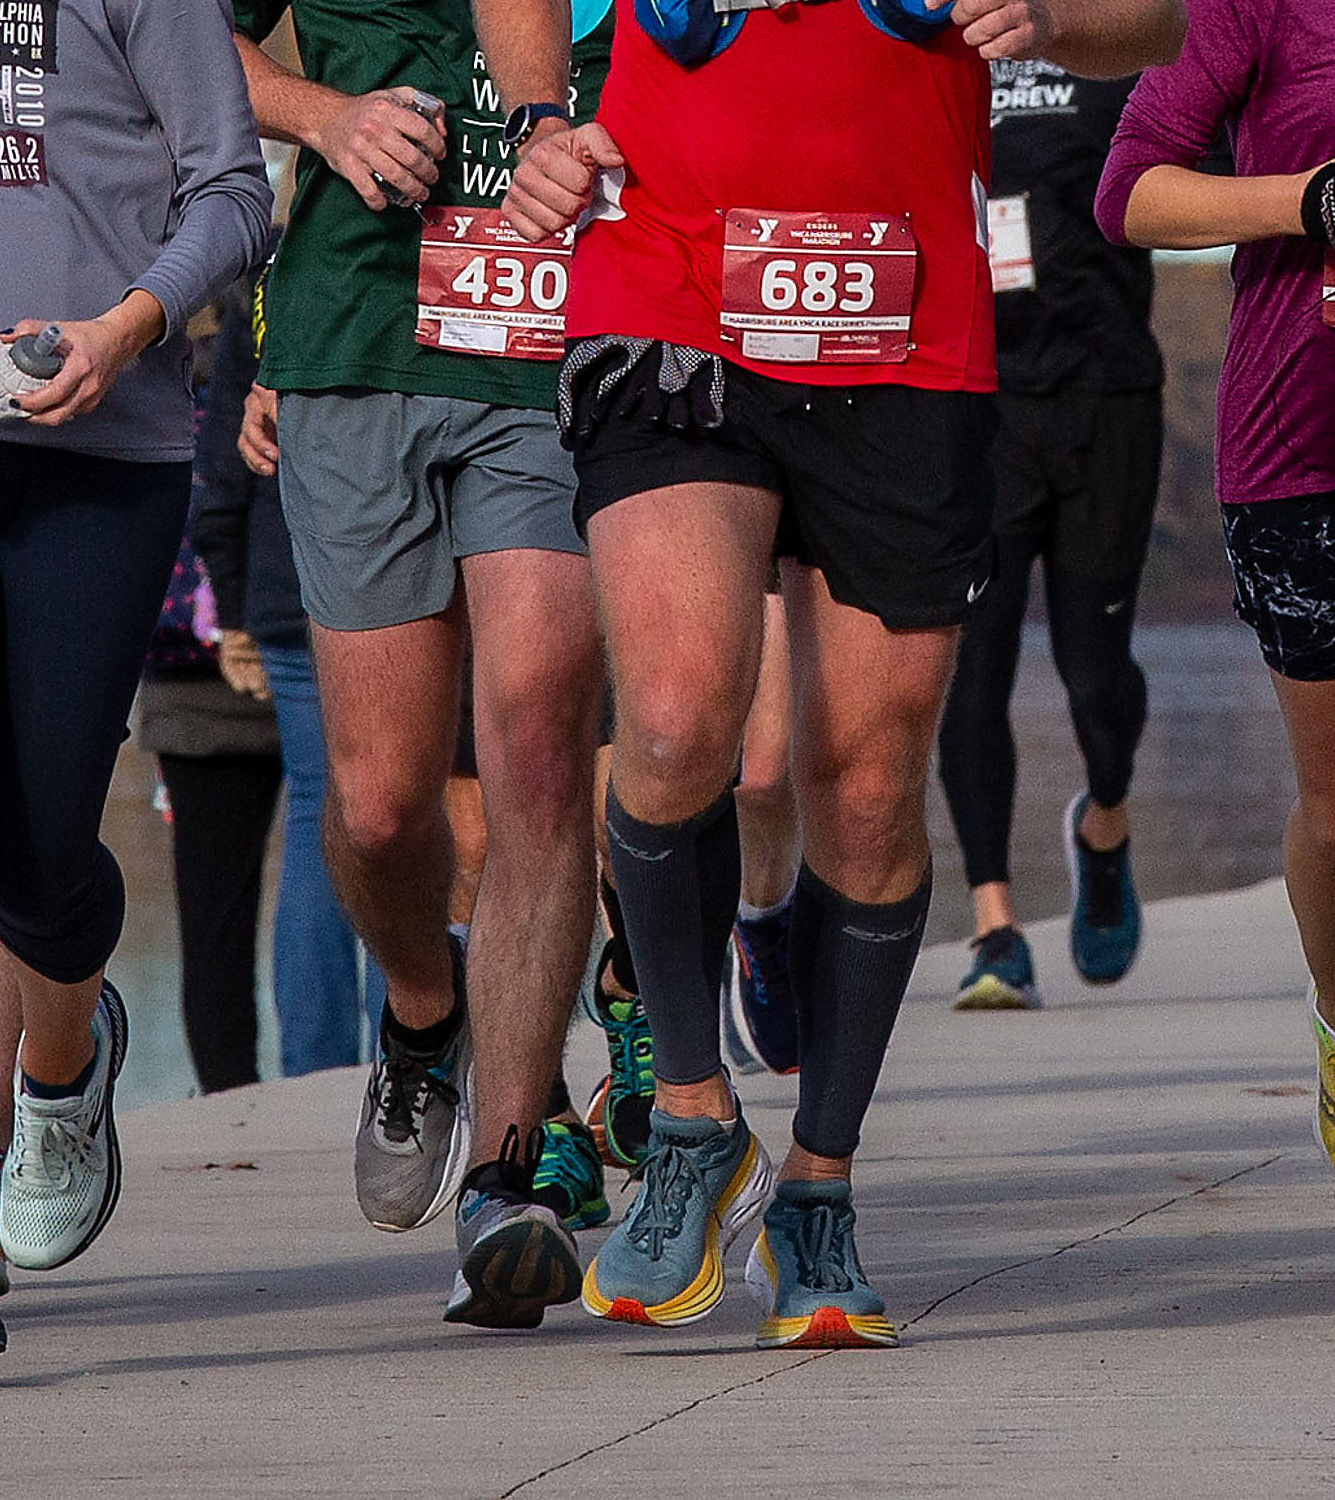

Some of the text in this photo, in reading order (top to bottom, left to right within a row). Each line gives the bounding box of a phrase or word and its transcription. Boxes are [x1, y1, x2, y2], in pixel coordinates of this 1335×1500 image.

[16, 67, 45, 127] 2010
[991, 84, 1074, 110] DREW
[0, 164, 41, 182] MILES
[451, 256, 568, 311] 430
[761, 259, 875, 312] 683
[778, 318, 798, 327] AREA
